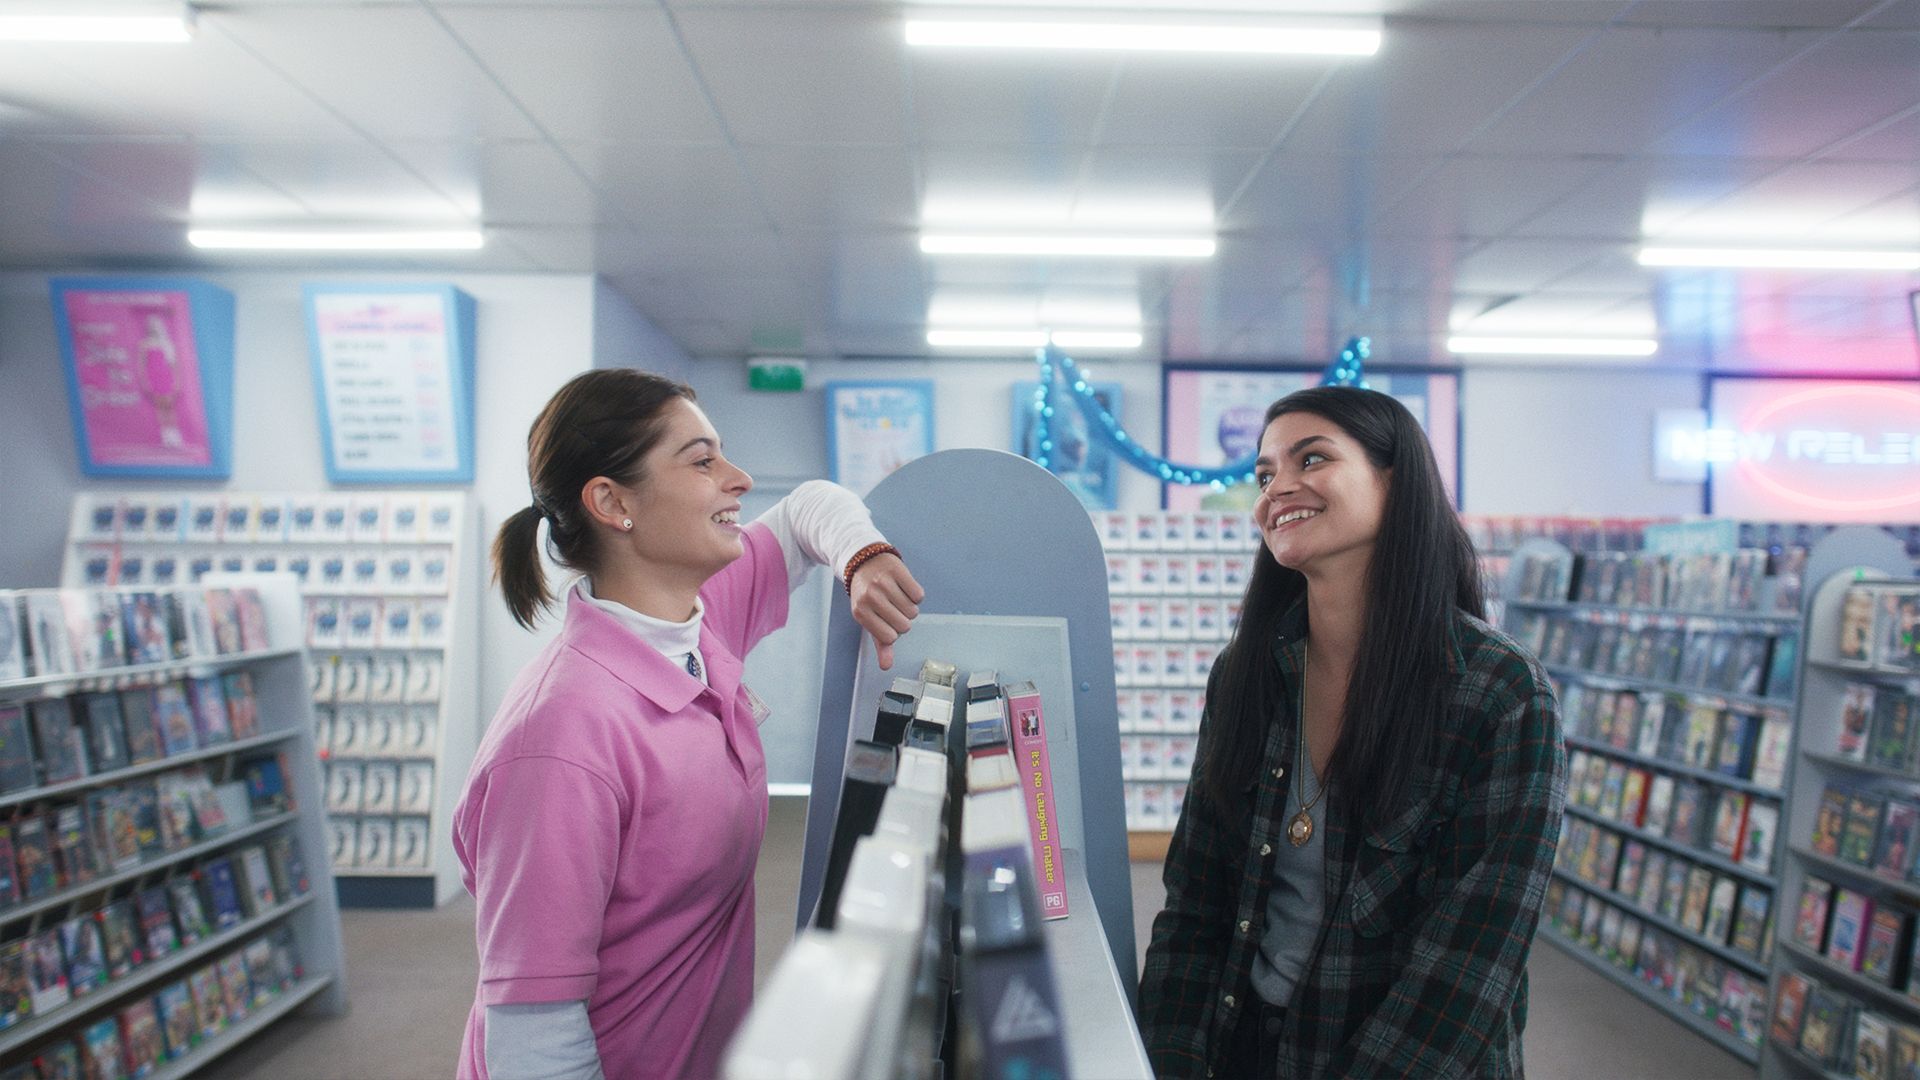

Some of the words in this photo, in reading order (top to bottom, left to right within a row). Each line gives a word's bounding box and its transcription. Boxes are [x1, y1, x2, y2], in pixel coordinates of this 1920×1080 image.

[1670, 429, 1776, 462] NEW
[1031, 751, 1041, 768] It's
[1033, 771, 1043, 788] No
[1036, 792, 1049, 841] Laughing
[1046, 895, 1061, 907] PG
